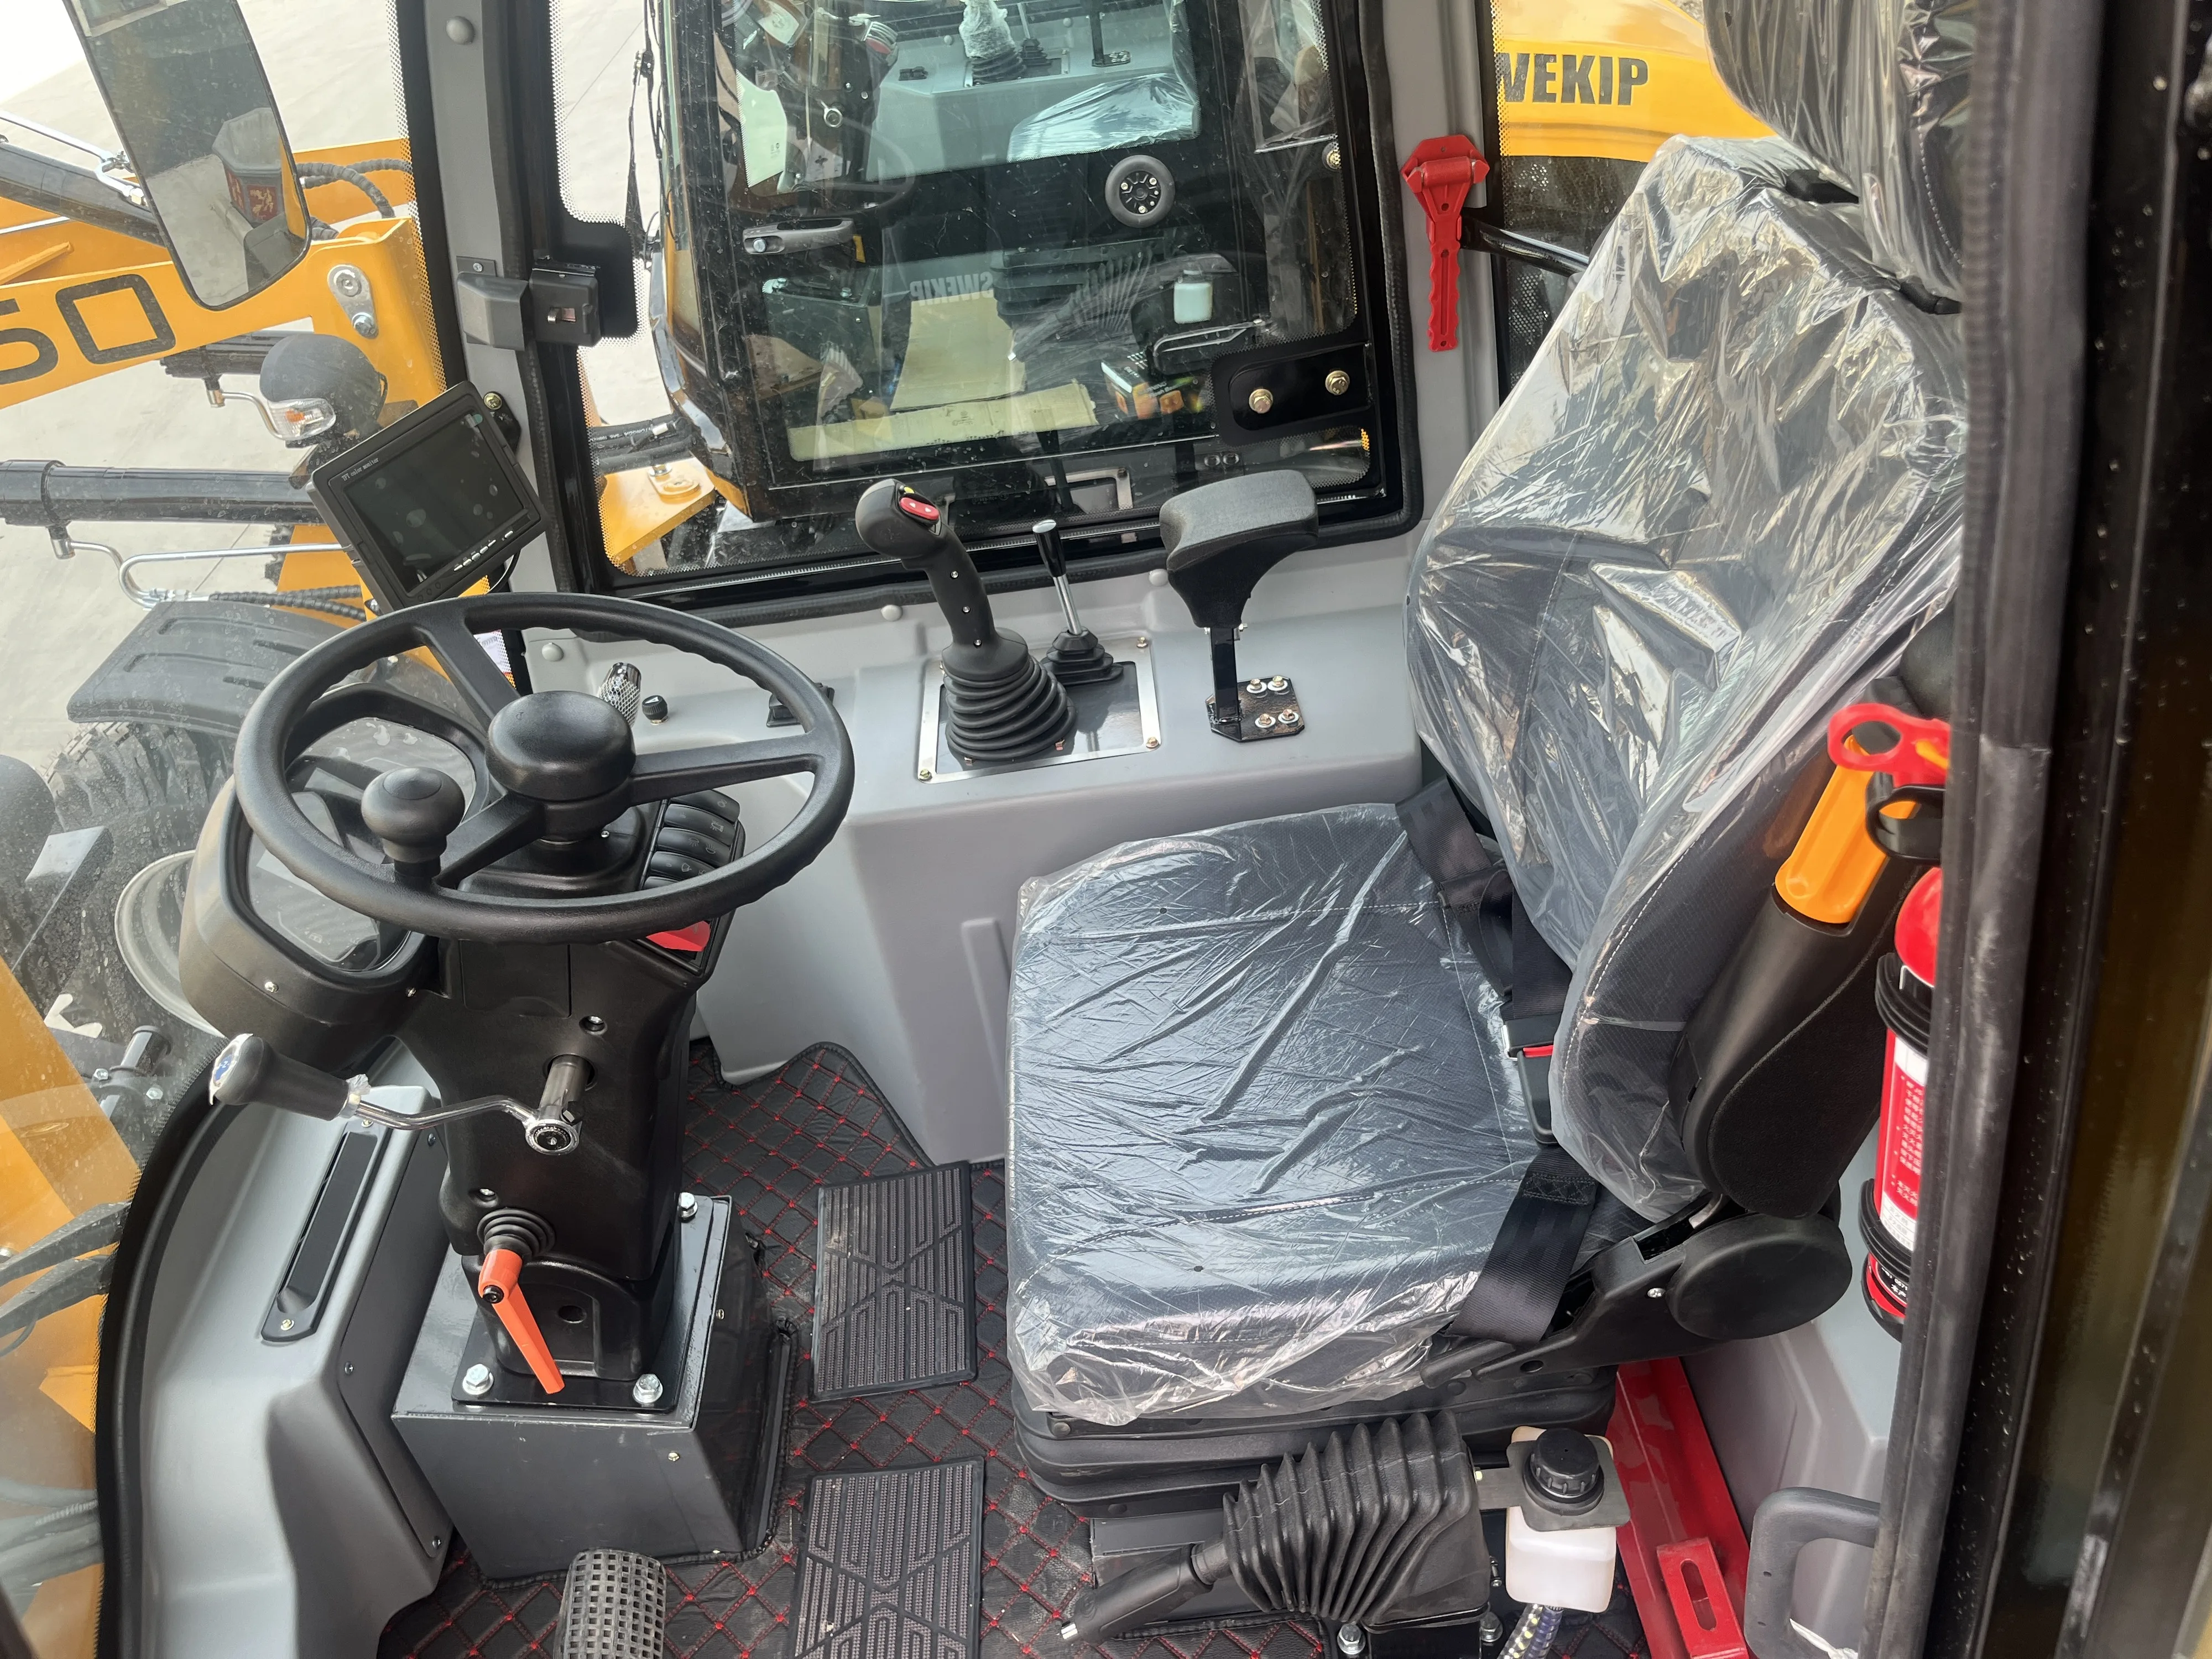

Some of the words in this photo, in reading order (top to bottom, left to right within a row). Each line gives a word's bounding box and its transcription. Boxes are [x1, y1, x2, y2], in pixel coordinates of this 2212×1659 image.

[341, 473, 351, 481] TFT
[351, 467, 362, 476] color
[362, 457, 379, 469] monitor
